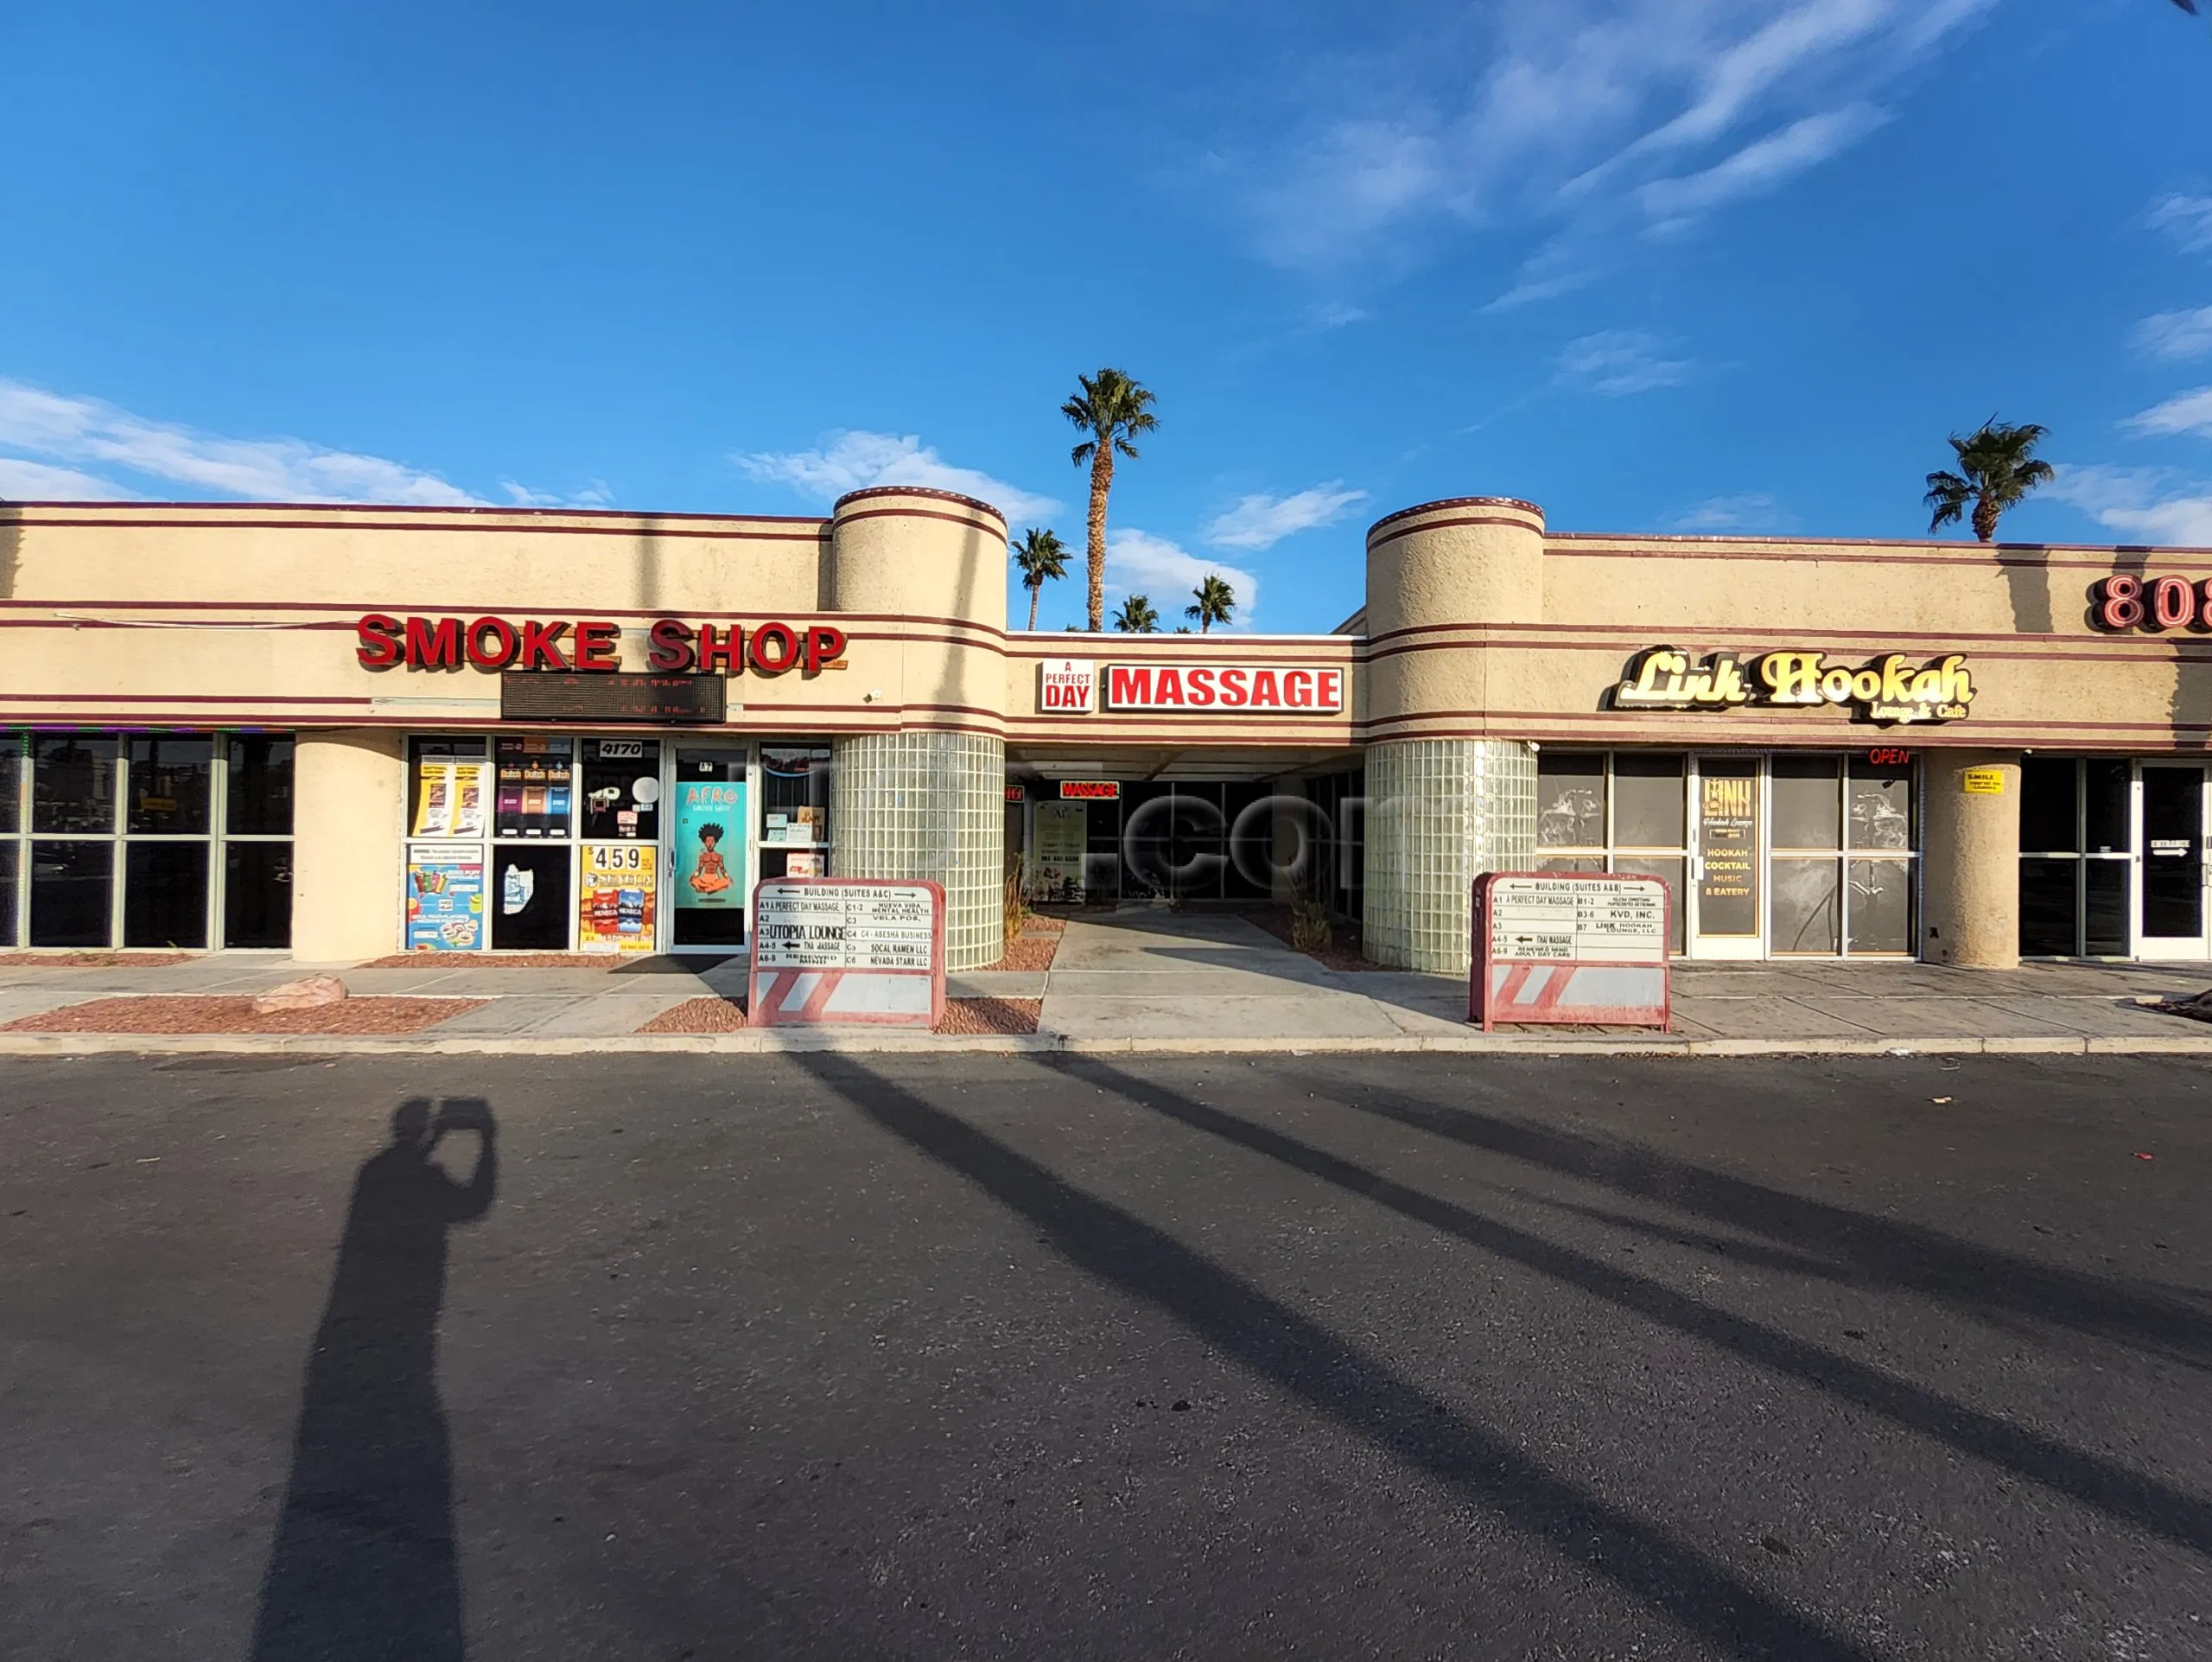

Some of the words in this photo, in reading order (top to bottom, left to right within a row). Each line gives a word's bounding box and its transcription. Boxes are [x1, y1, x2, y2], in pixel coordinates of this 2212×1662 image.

[2104, 574, 2212, 628] 80
[355, 614, 620, 670] SMOKE
[649, 620, 847, 672] SHOP
[1065, 661, 1072, 672] A
[1046, 673, 1090, 685] PERFECT
[1619, 653, 1746, 702] Link
[1762, 652, 1974, 704] Hookah
[1111, 667, 1340, 708] MASSAGE
[1046, 685, 1090, 708] DAY
[1870, 701, 1914, 724] Lounge
[1919, 702, 1932, 718] &
[1937, 704, 1967, 718] Cafe
[601, 743, 641, 755] 4170
[1870, 748, 1910, 764] OPEN
[1062, 781, 1117, 798] MASSAGE
[686, 786, 738, 806] AFRO
[1704, 779, 1751, 817] LINK
[1707, 848, 1748, 857] HOOKAH
[1705, 862, 1751, 870] COCKTAIL
[804, 888, 839, 896] BUILDING
[842, 888, 871, 900] (SUITES
[873, 889, 892, 901] A&C)
[1535, 882, 1571, 892] BUILDING
[1573, 883, 1601, 894] (SUITES
[1604, 883, 1622, 895] A&B)
[1713, 888, 1750, 896] EATERY
[775, 901, 799, 911] PERFECT
[801, 902, 812, 911] DAY
[814, 902, 839, 912] MASSAGE
[1511, 895, 1535, 904] PERFECT
[1536, 895, 1547, 905] DAY
[1548, 896, 1573, 906] MASSAGE
[1611, 910, 1633, 920] KVD,
[770, 925, 806, 939] UTOPIA
[810, 926, 846, 940] LOUNGE
[874, 930, 899, 939] ABESHA
[901, 931, 931, 939] BUSINESS
[1536, 935, 1548, 944] THAI
[1549, 935, 1572, 945] MASSAGE
[871, 944, 891, 952] SOCAL
[893, 944, 914, 953] RAMEN
[916, 945, 928, 954] LLC
[870, 956, 894, 965] NEVADA
[896, 957, 915, 965] STARR
[917, 958, 928, 966] LLC
